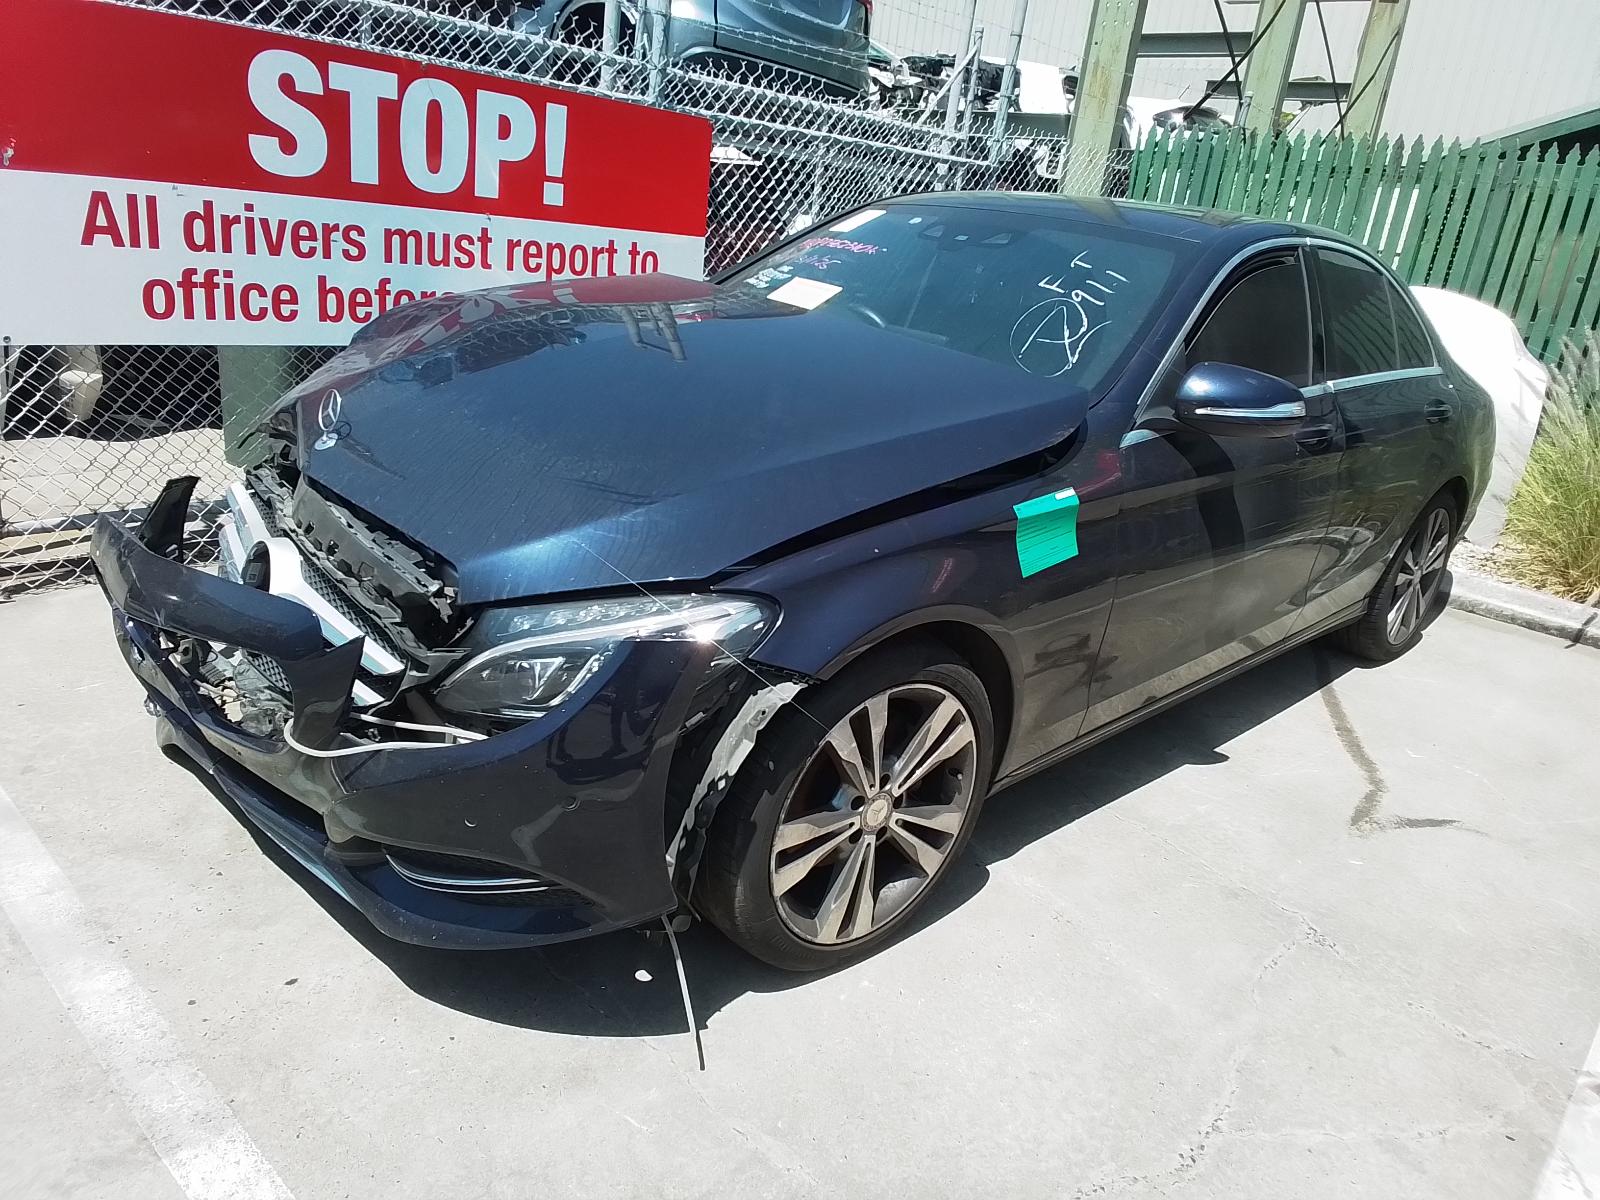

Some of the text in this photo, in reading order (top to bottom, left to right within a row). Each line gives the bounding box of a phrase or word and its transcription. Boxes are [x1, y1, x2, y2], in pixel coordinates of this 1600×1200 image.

[247, 48, 569, 207] STOP!
[80, 190, 660, 280] All drivers must report to
[141, 267, 454, 323] office bef
